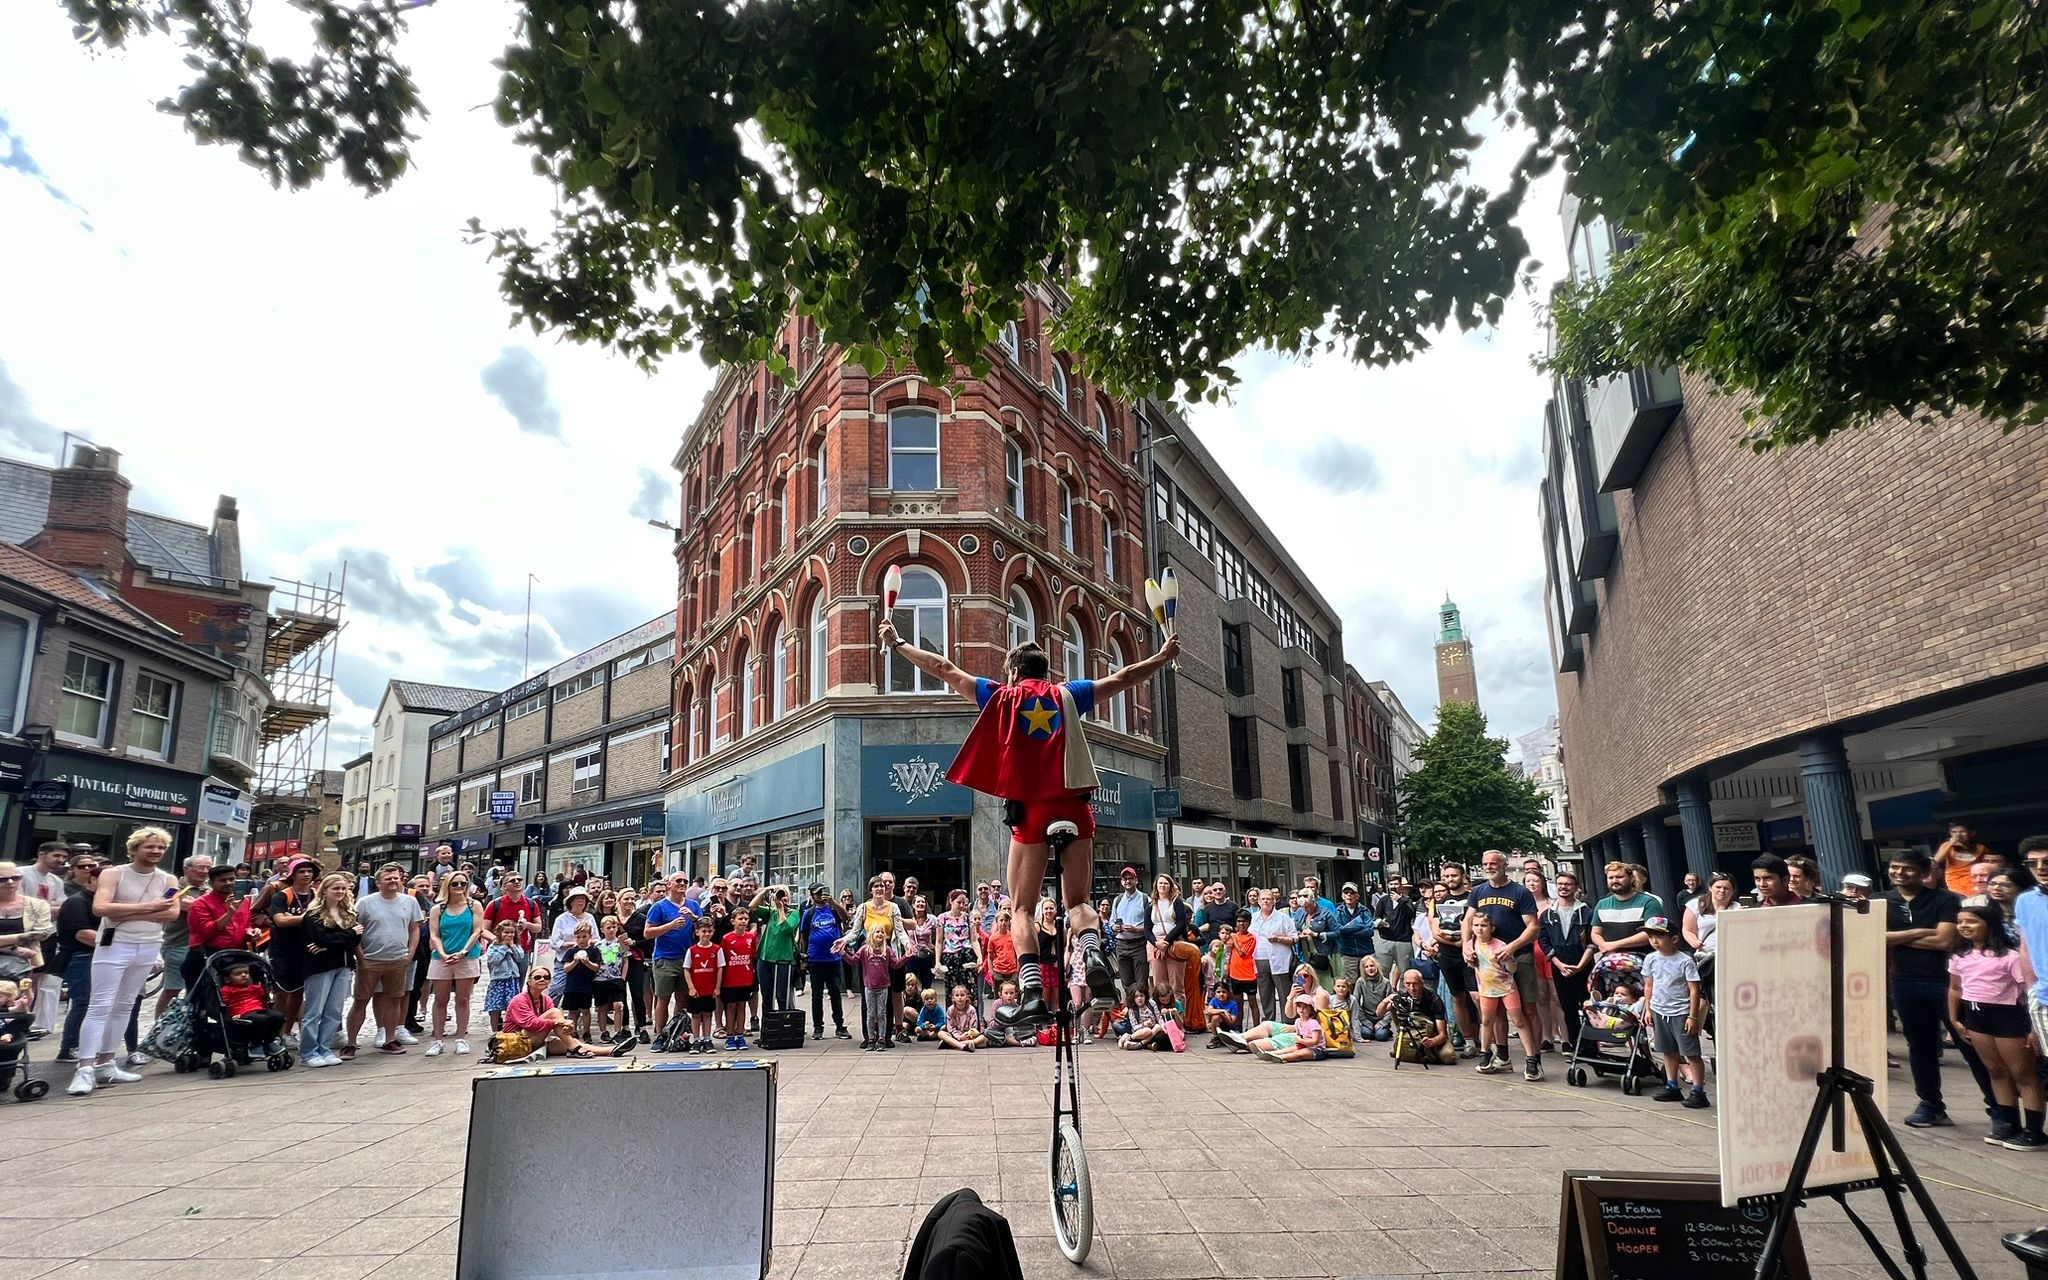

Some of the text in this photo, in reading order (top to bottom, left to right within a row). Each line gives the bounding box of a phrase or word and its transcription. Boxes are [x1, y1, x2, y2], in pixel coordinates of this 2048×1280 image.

[72, 774, 178, 803] VINTAGE EMPORIUM
[493, 805, 513, 813] TO LET
[581, 823, 597, 833] CREW
[597, 819, 625, 831] CLOTHING
[1716, 825, 1754, 833] TESCO
[1477, 896, 1515, 909] GOLDEN STATE
[1599, 1202, 1621, 1214] THE
[1616, 1242, 1660, 1254] HOOPER
